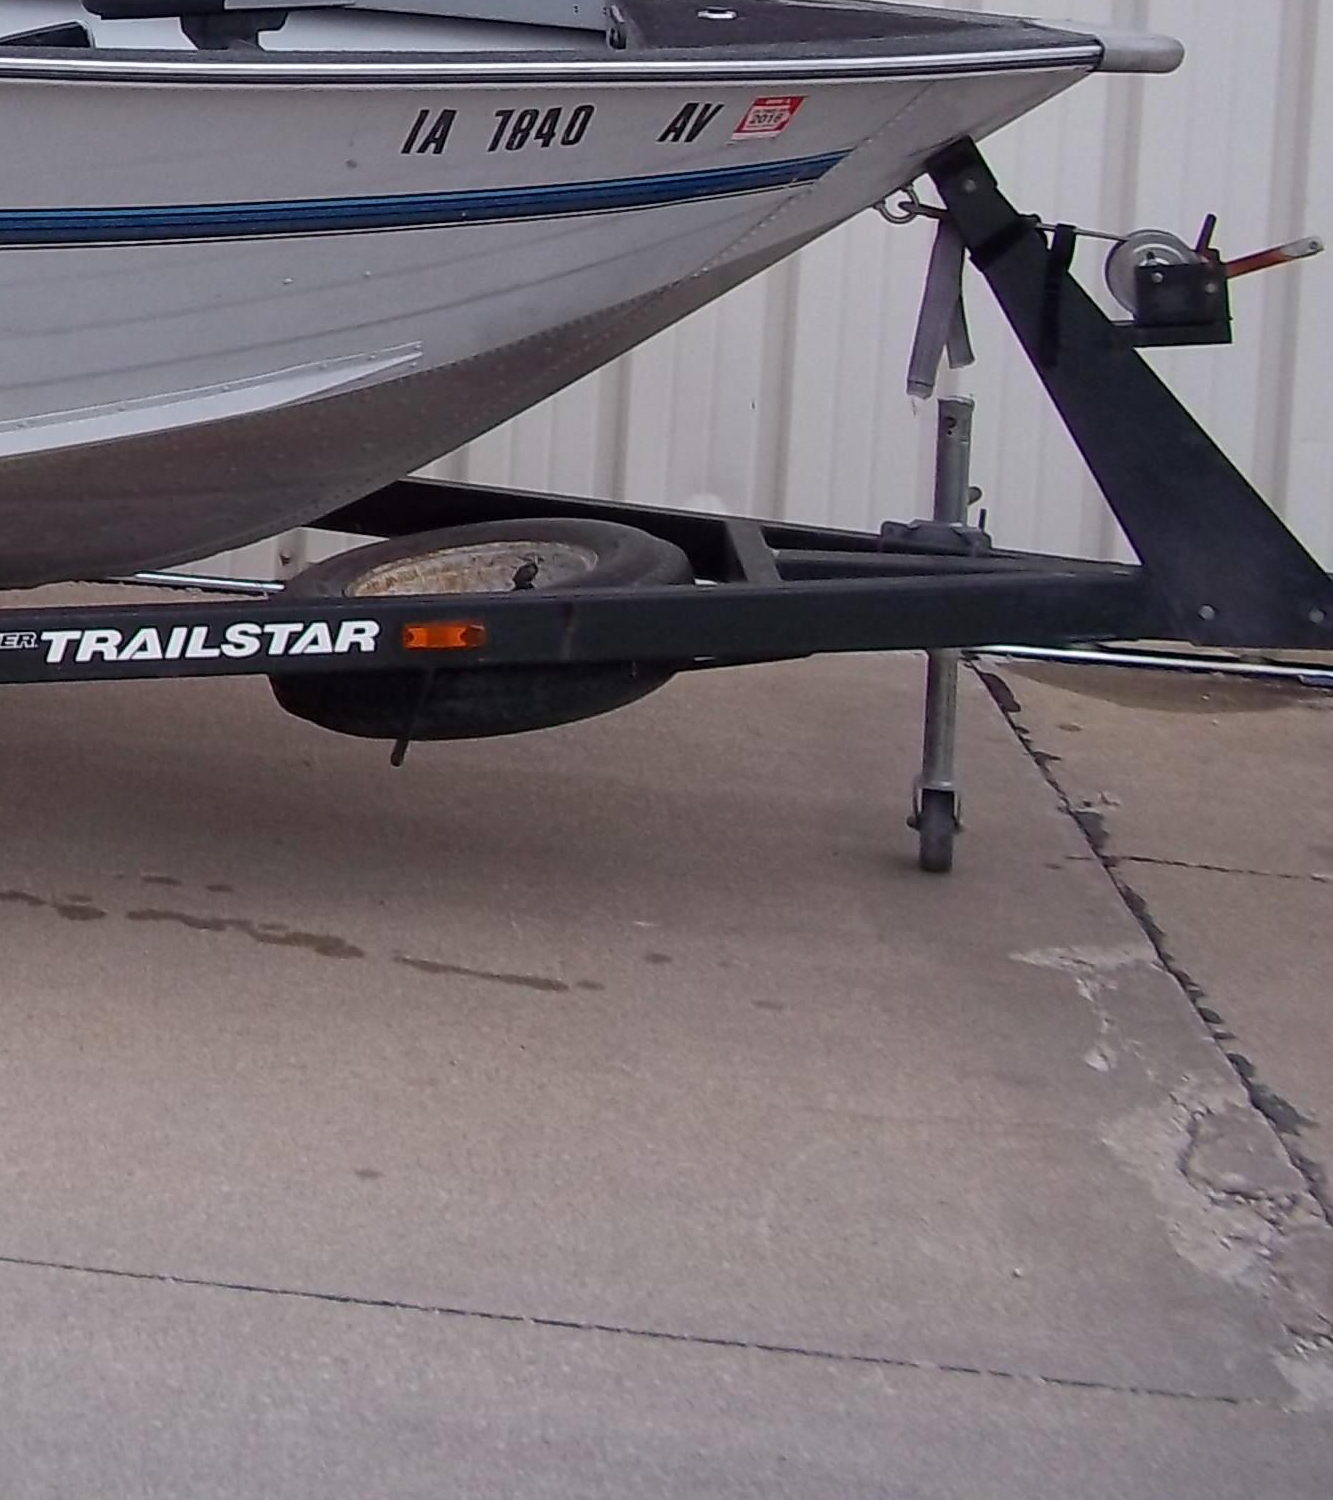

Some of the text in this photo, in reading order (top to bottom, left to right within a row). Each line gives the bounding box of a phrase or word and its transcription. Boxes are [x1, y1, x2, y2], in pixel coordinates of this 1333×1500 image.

[400, 102, 725, 155] IA 7840 AV
[40, 620, 381, 664] TRAILSTAR
